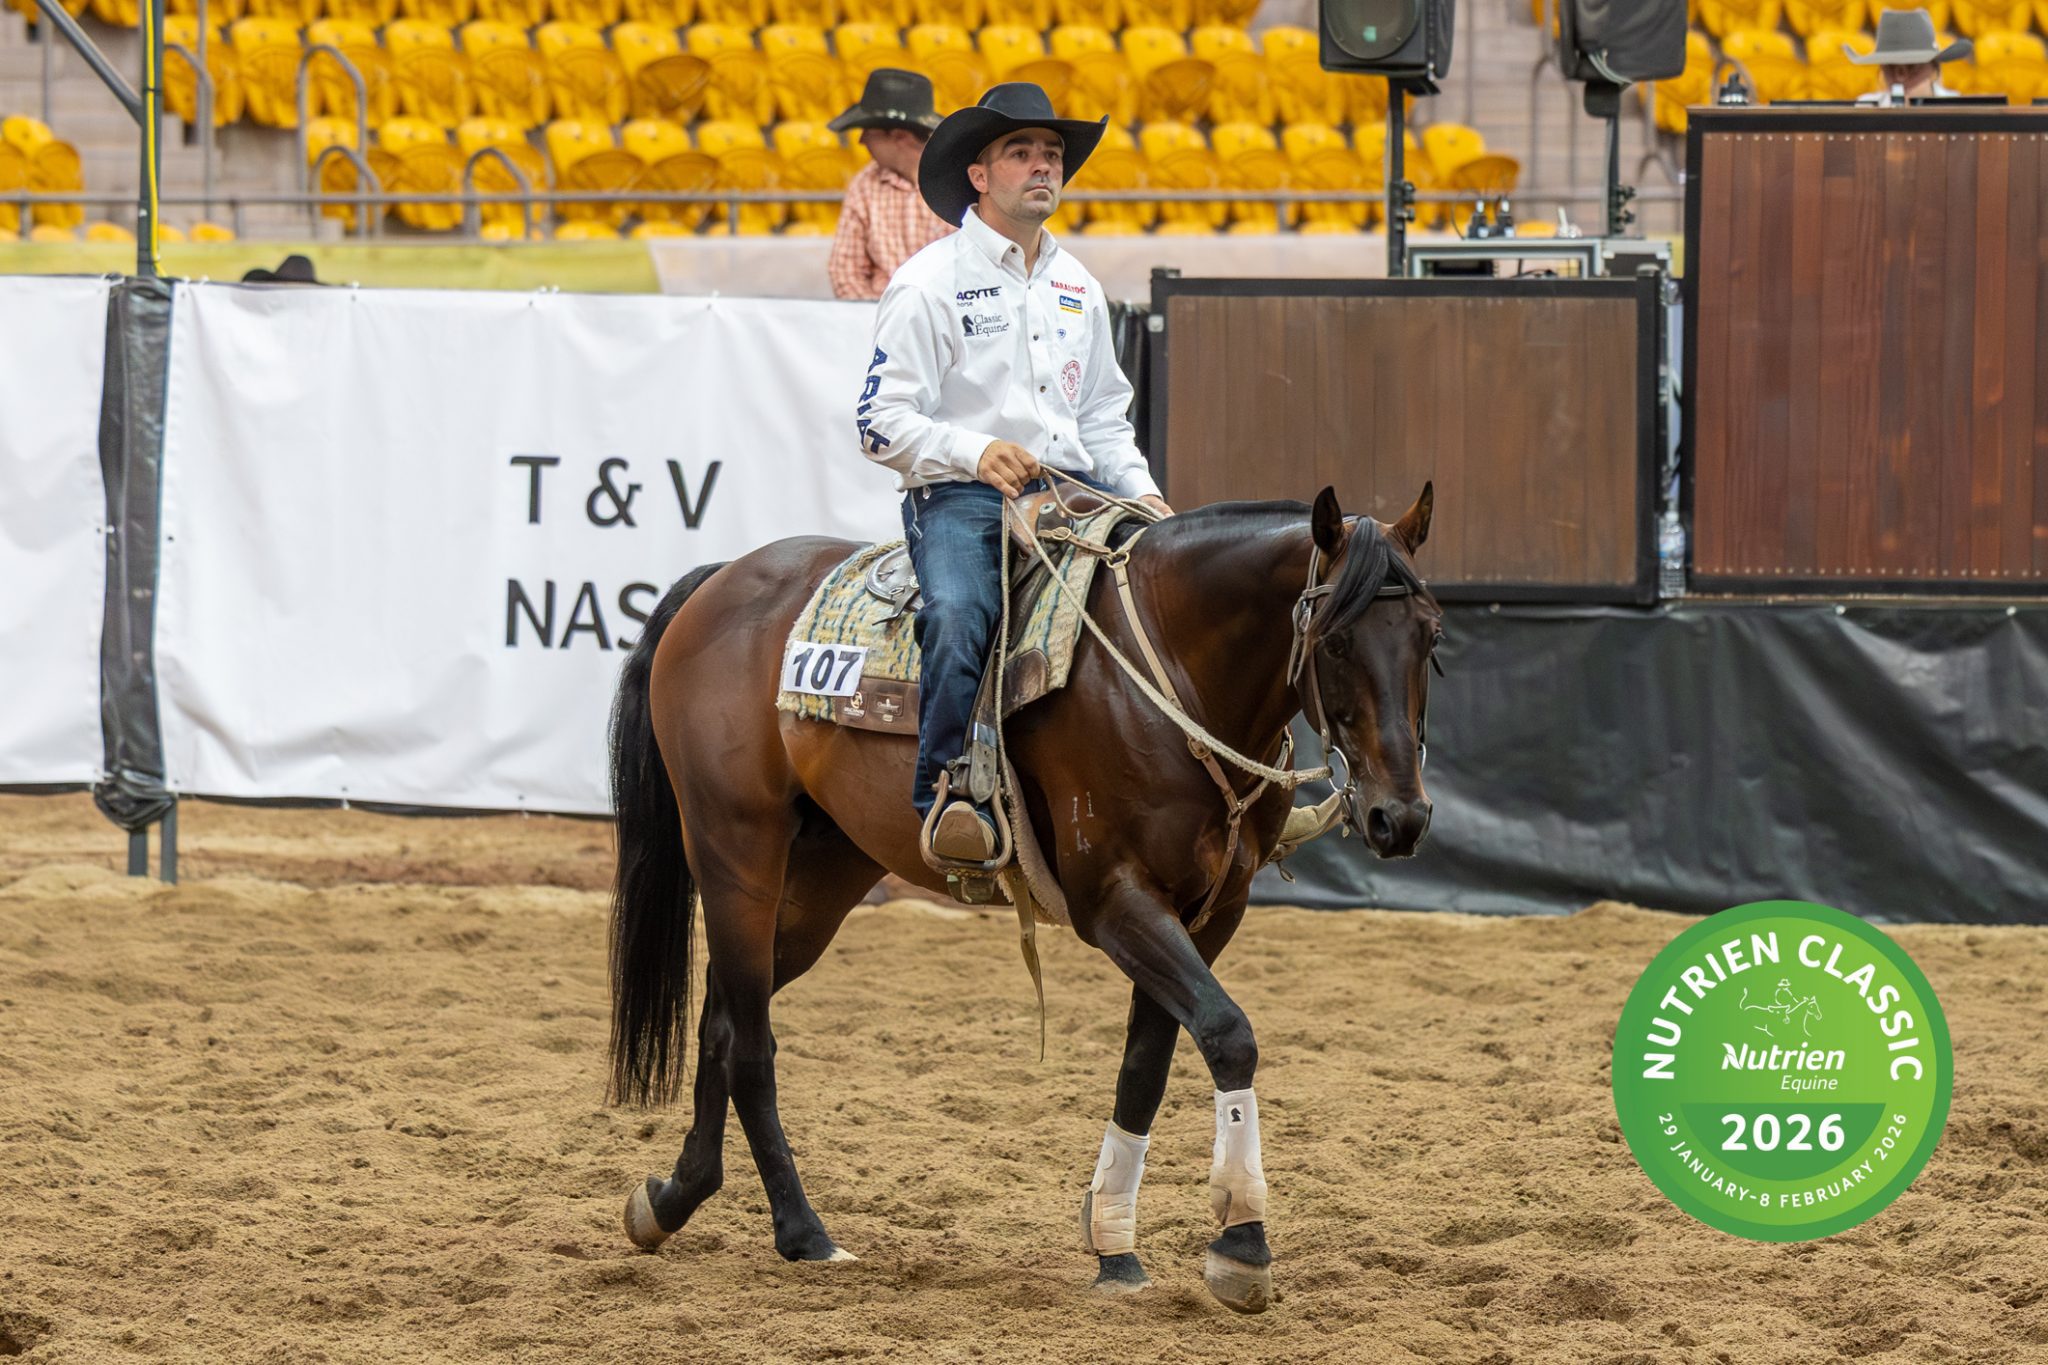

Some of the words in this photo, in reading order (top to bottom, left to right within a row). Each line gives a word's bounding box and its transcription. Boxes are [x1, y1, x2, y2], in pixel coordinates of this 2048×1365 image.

[956, 286, 1001, 301] 4CYTE
[974, 314, 1002, 325] Classic
[975, 323, 1008, 337] Equine
[510, 456, 560, 524] T
[586, 457, 643, 528] &
[666, 459, 723, 530] V
[793, 647, 862, 691] 107
